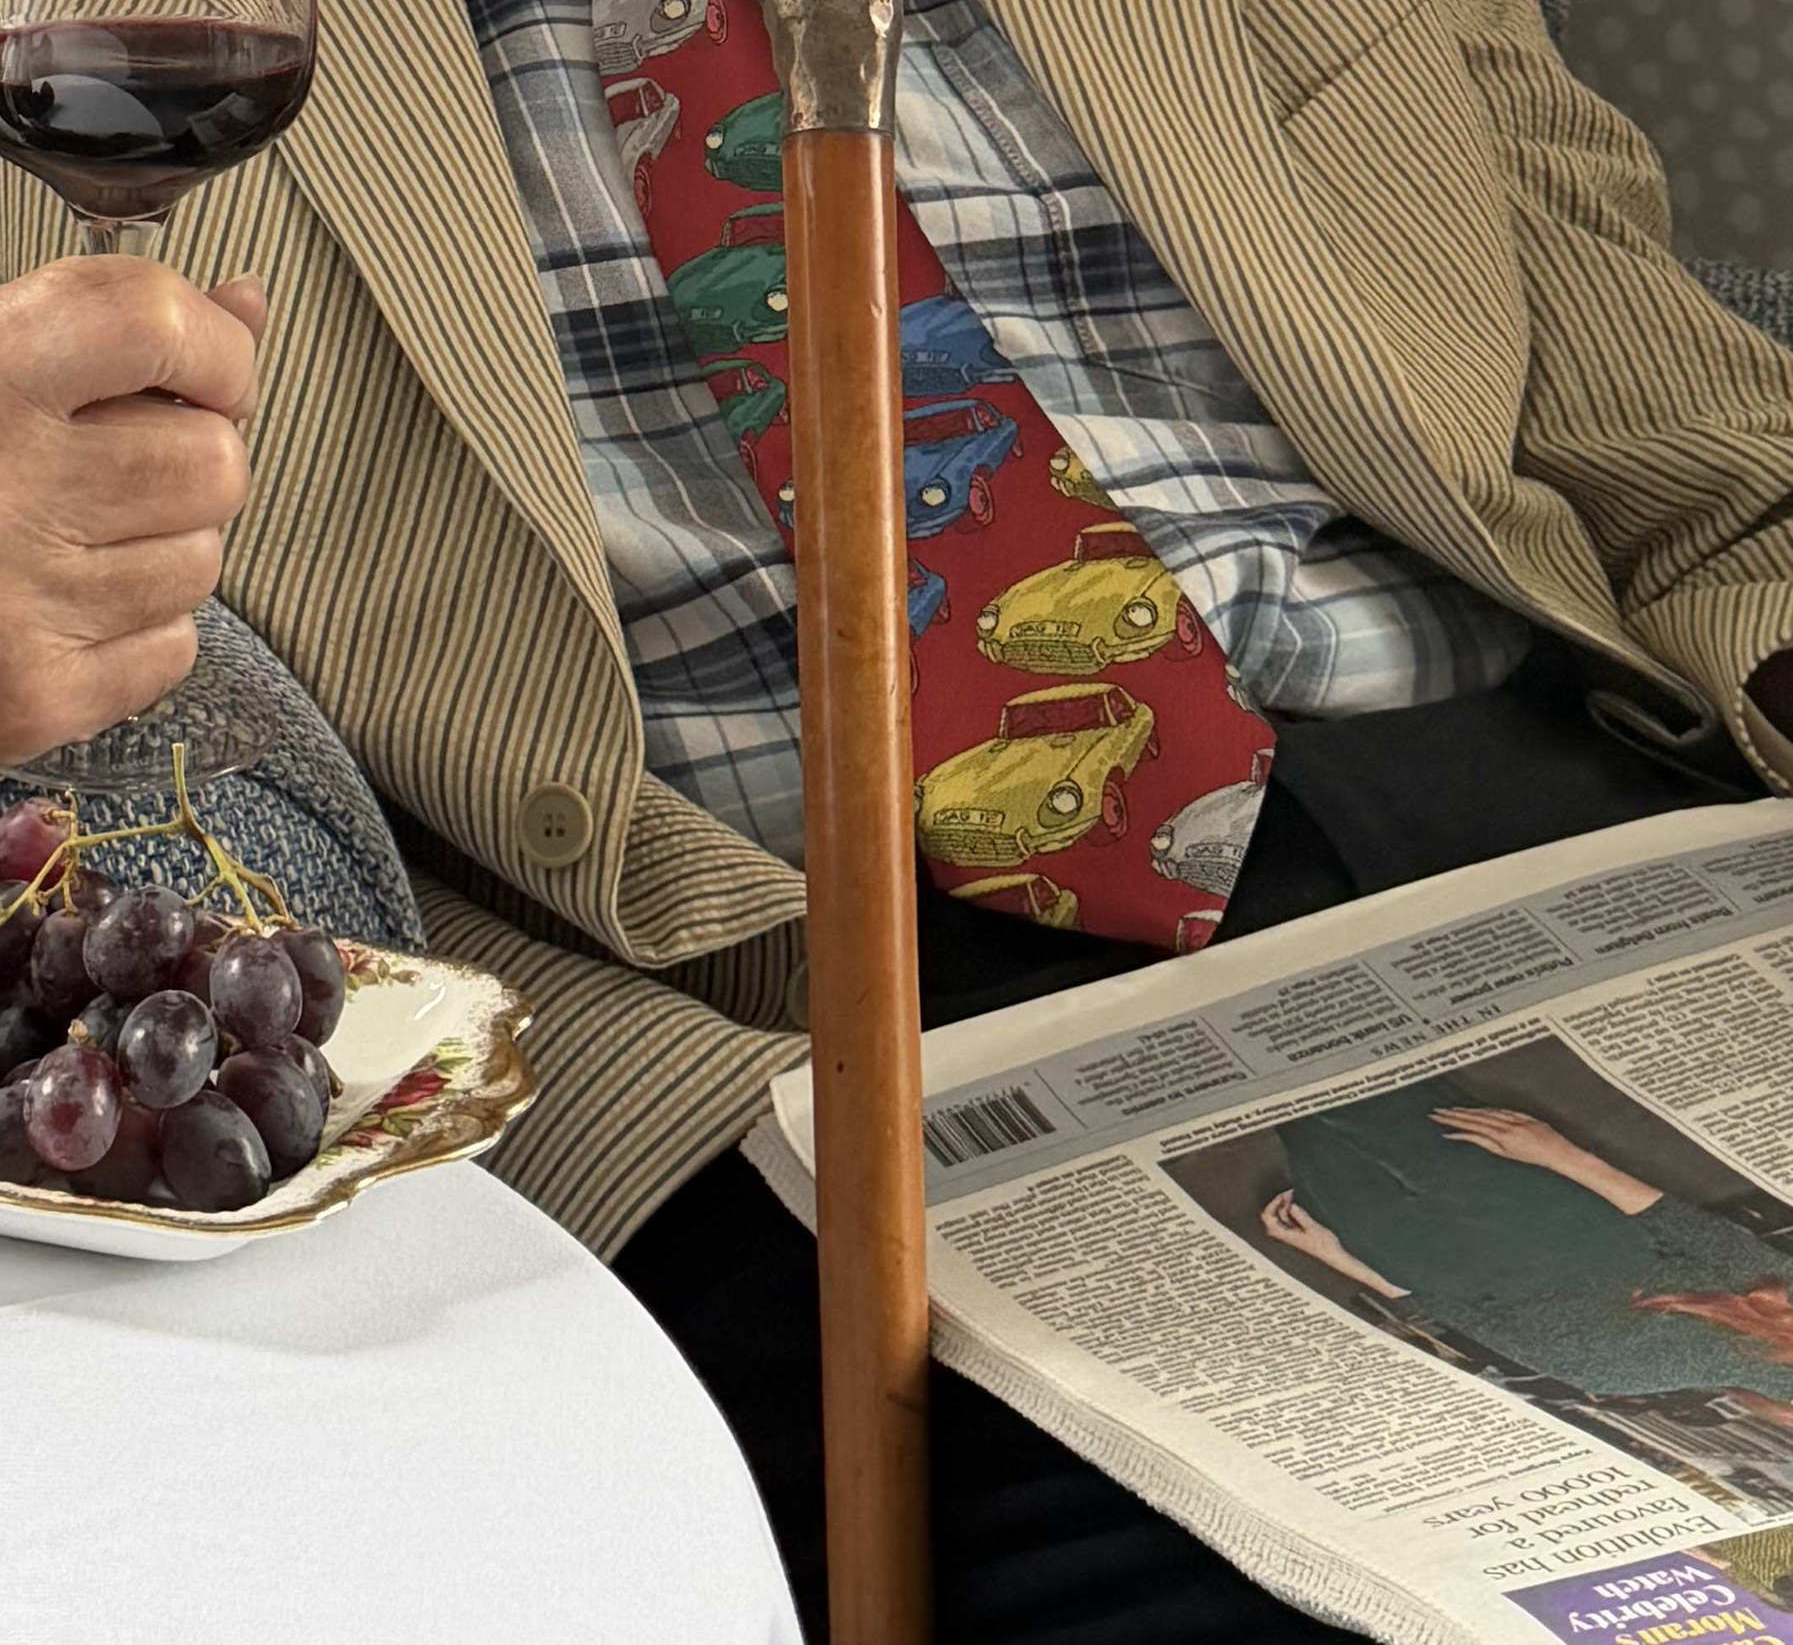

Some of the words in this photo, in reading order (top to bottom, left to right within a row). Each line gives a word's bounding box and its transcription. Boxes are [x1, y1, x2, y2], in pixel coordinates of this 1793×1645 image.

[1431, 1016, 1470, 1035] THE
[1477, 1003, 1502, 1020] IN
[1370, 1032, 1426, 1058] NEWS
[1519, 1466, 1634, 1504] 10,000
[1421, 1495, 1513, 1529] years
[1517, 1480, 1659, 1526] redhead
[1543, 1495, 1690, 1544] favoured
[1467, 1516, 1520, 1540] for
[1508, 1536, 1535, 1551] a
[1552, 1515, 1725, 1572] Evolution
[1483, 1552, 1554, 1582] has
[1592, 1564, 1716, 1601] Watch
[1568, 1584, 1737, 1633] Celebrity
[1615, 1607, 1768, 1645] Morans
